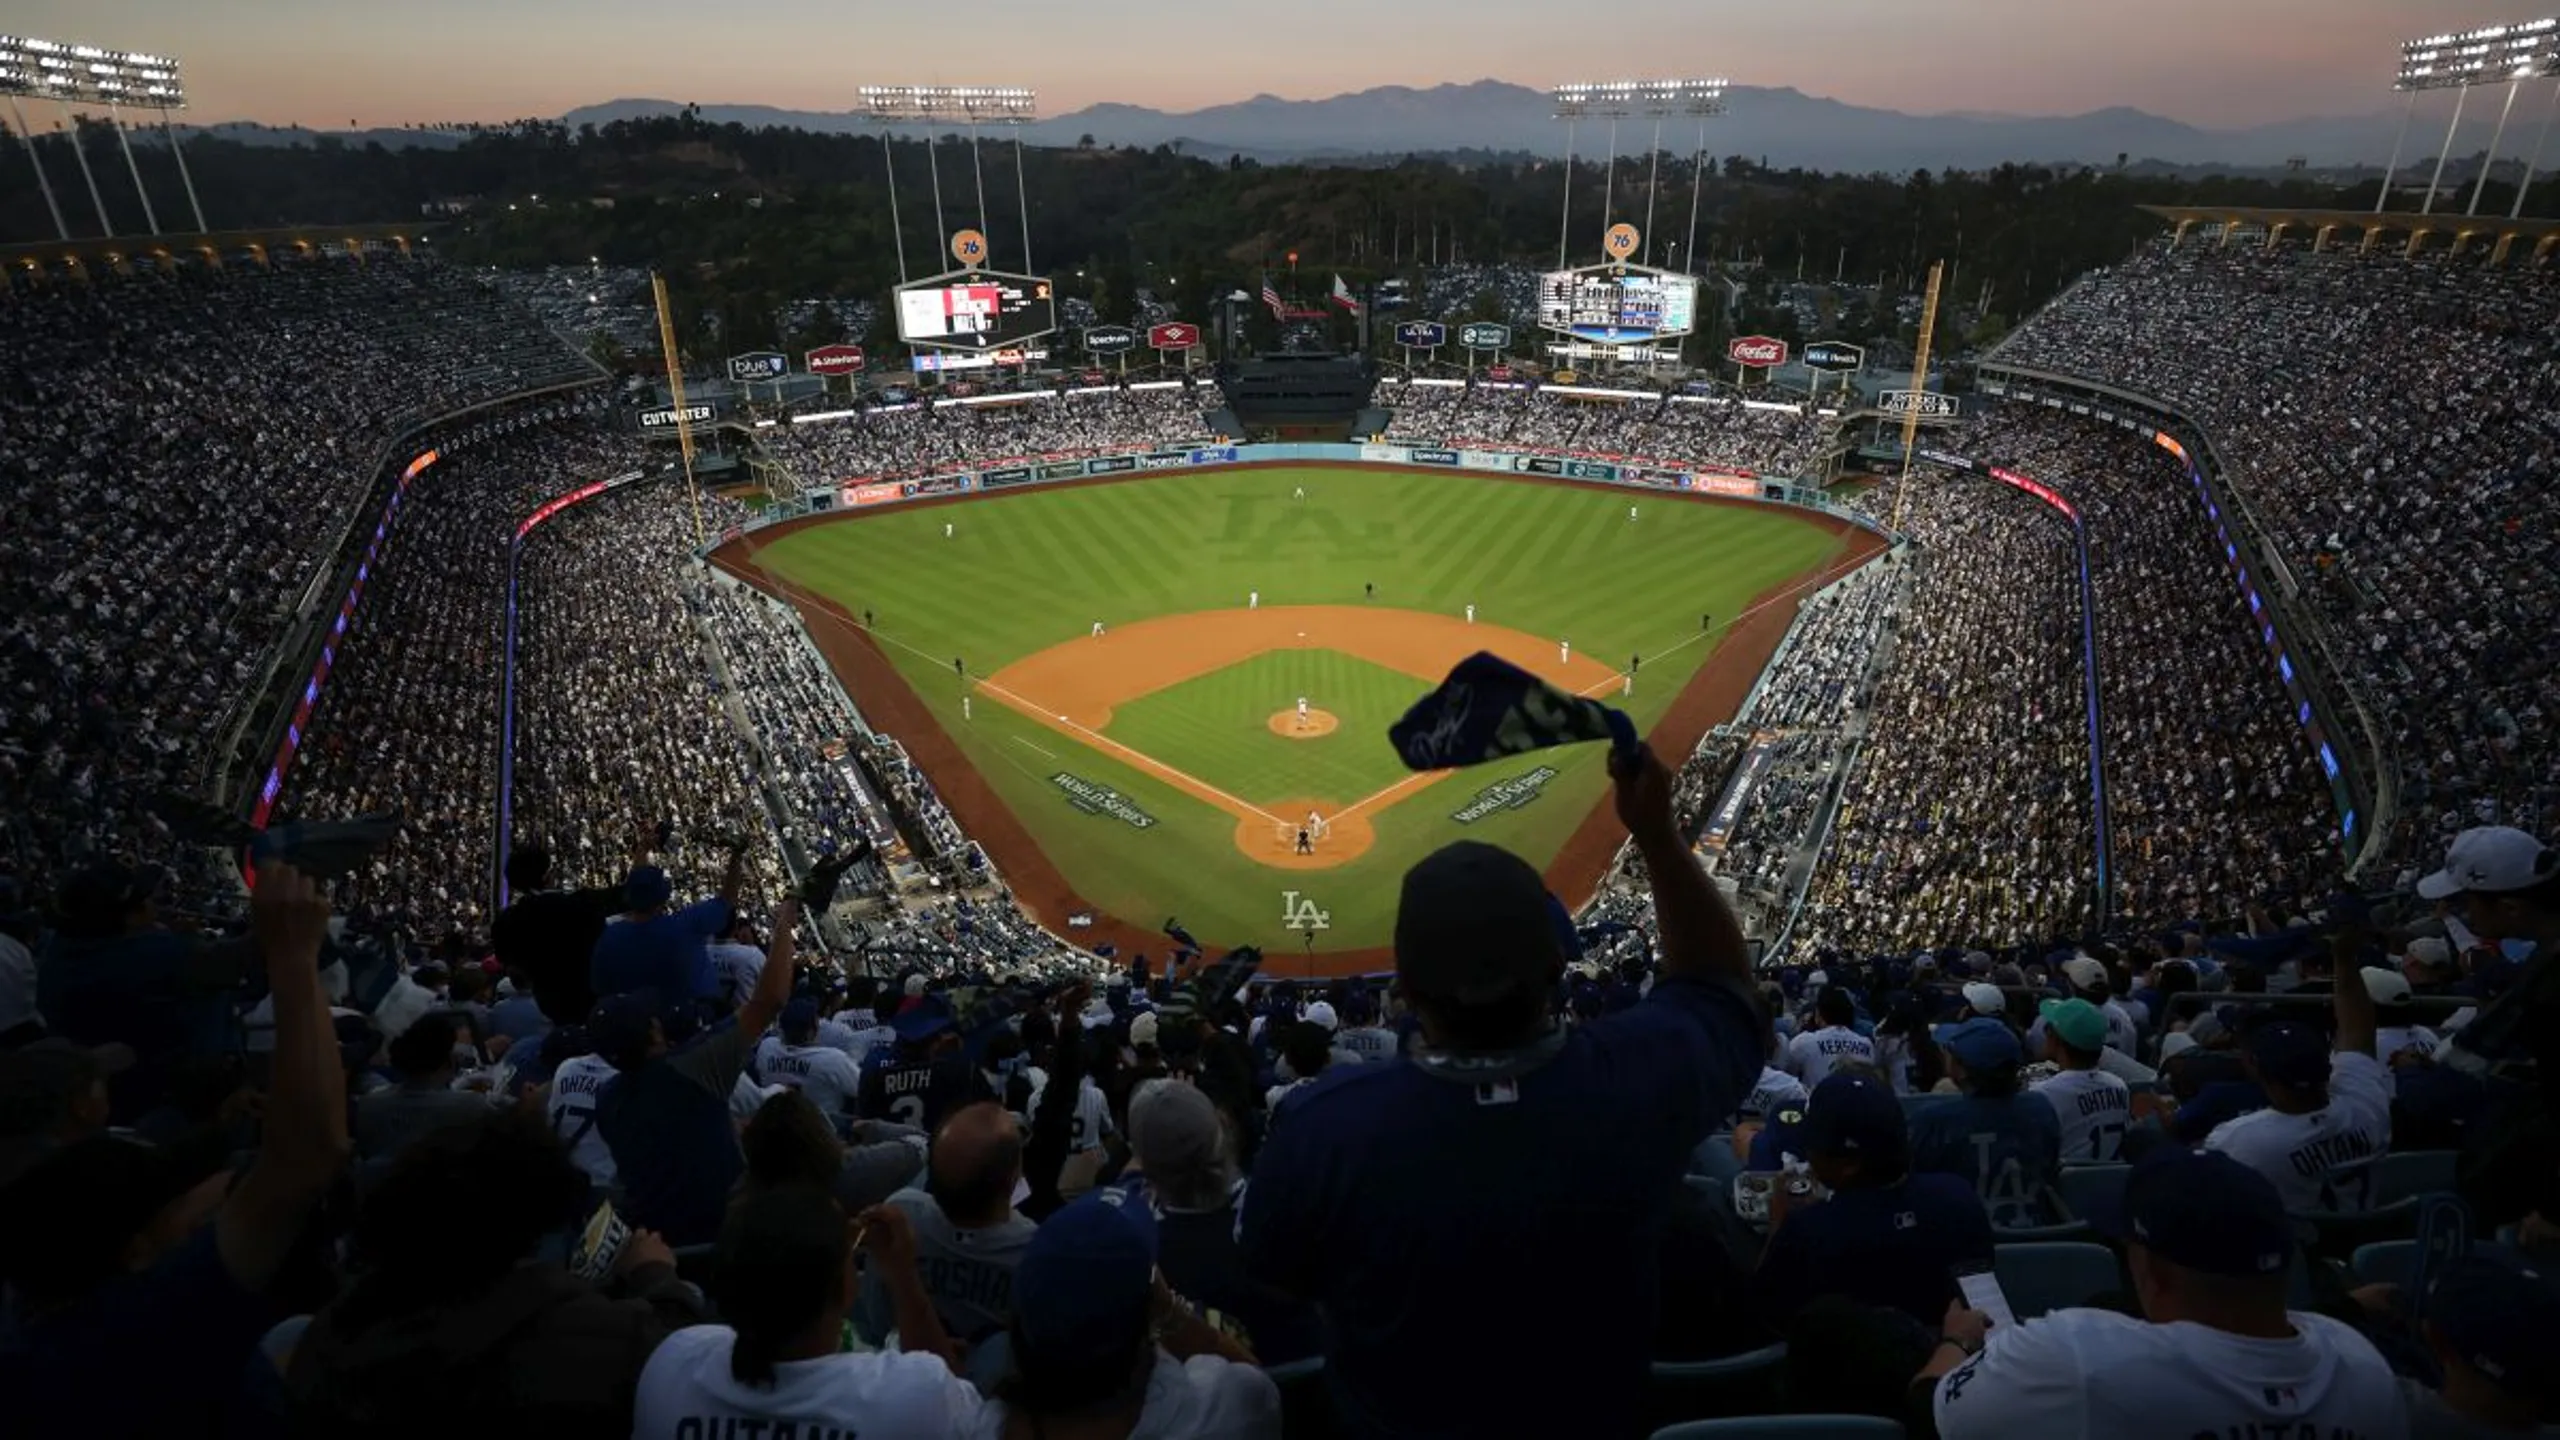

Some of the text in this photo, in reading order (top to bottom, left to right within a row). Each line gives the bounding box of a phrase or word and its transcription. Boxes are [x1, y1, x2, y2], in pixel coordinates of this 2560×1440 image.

[963, 240, 979, 254] 76
[1613, 234, 1630, 248] 76
[641, 407, 710, 426] CUTWATER
[1282, 891, 1330, 930] LA
[884, 1067, 932, 1096] RUTH
[2290, 1125, 2371, 1177] OHTANI
